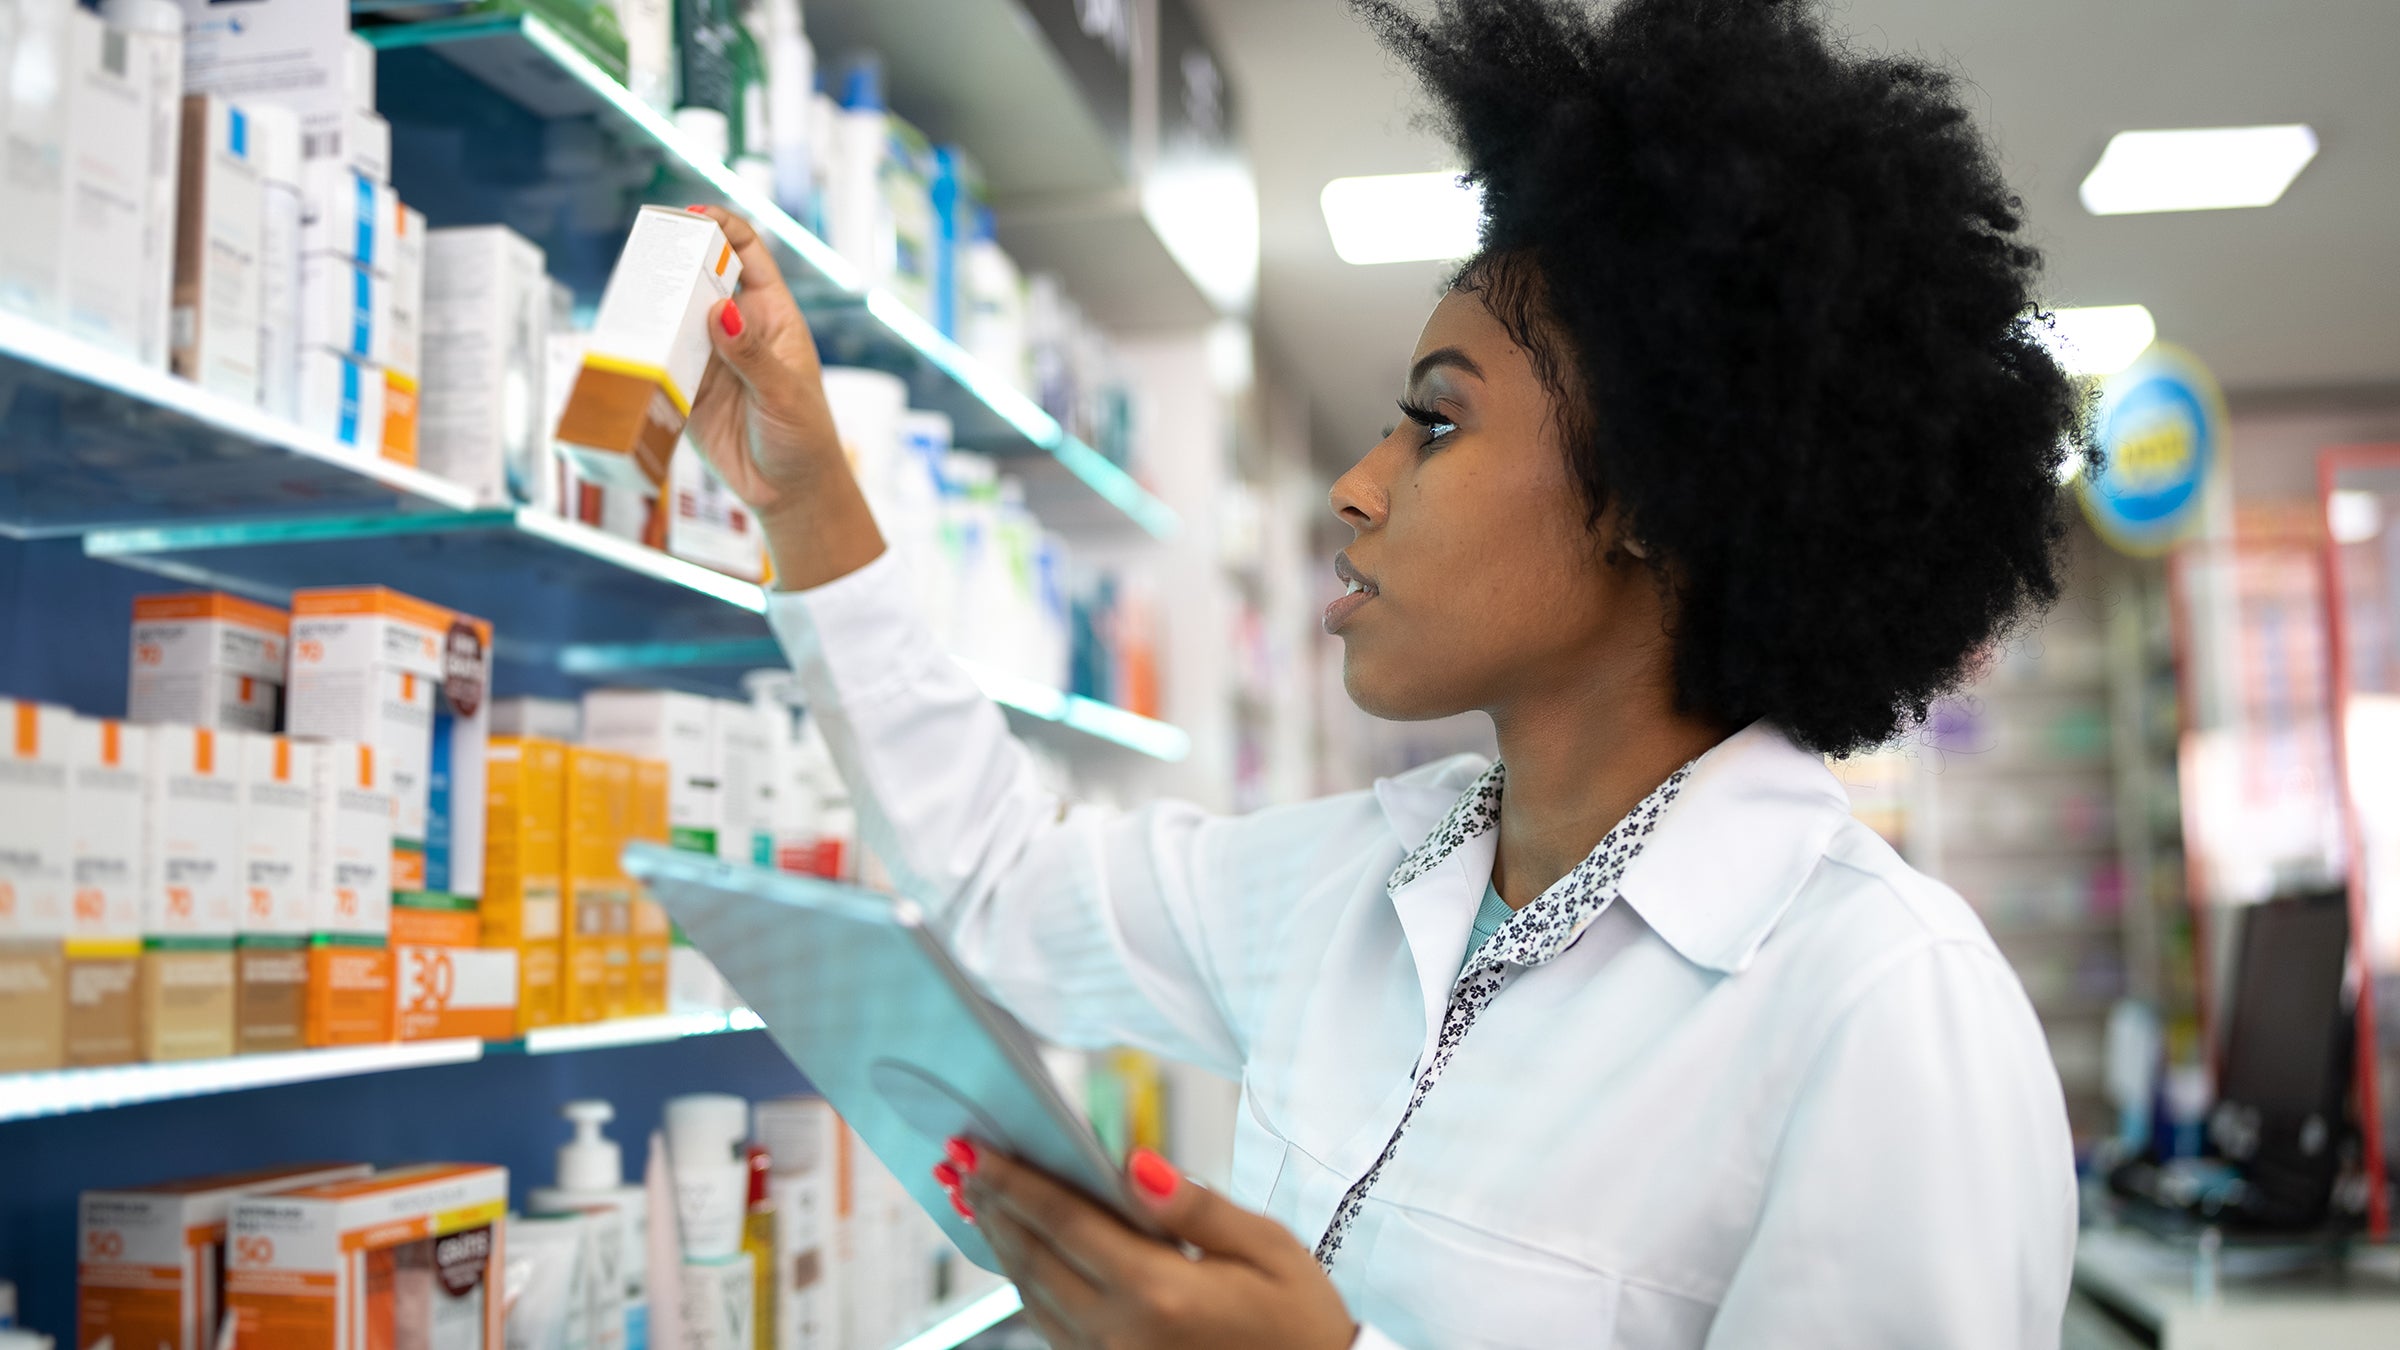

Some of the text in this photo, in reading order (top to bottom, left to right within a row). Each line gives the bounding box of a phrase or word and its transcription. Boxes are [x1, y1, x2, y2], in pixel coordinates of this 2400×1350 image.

[410, 949, 455, 1012] 30
[87, 1230, 124, 1258] 50
[236, 1235, 274, 1265] 50
